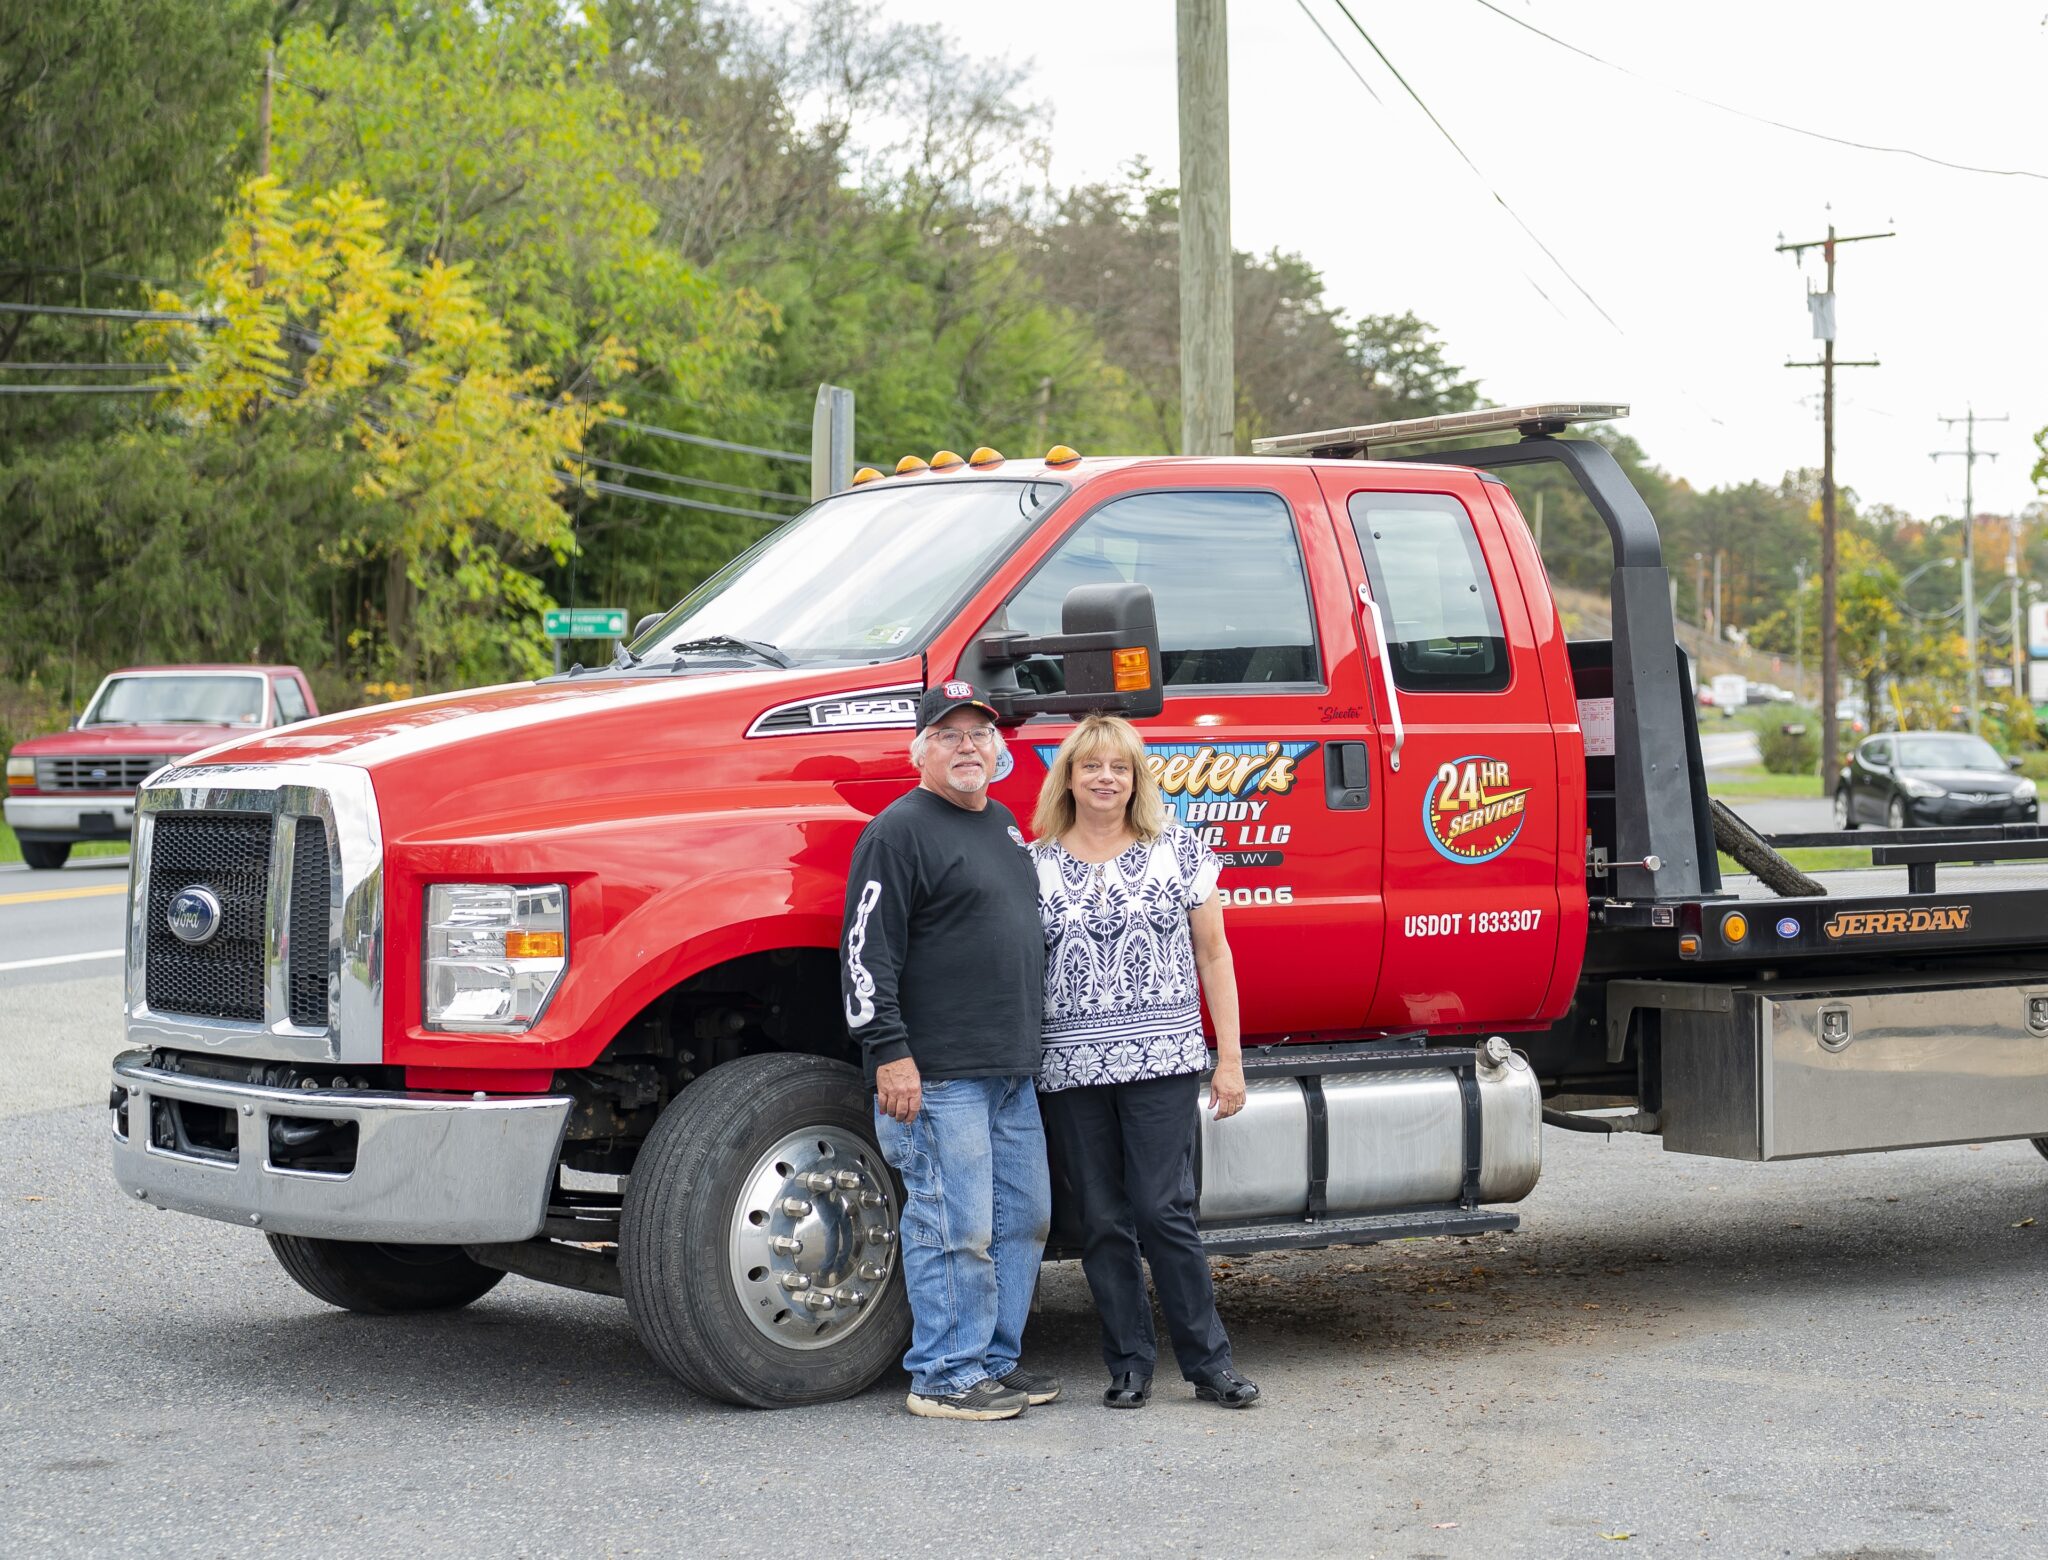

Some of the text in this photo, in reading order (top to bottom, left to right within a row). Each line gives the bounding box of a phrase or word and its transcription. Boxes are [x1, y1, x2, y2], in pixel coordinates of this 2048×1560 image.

[1146, 741, 1295, 796] eeter's
[1438, 762, 1510, 811] 24 HR
[1186, 801, 1268, 822] BODY
[1449, 793, 1527, 839] SERVICE
[1238, 825, 1292, 845] LLC
[1241, 853, 1268, 864] WV
[173, 899, 206, 928] Ford
[1404, 909, 1542, 938] USDOT 1833307
[1826, 909, 1970, 938] JERR-DAN
